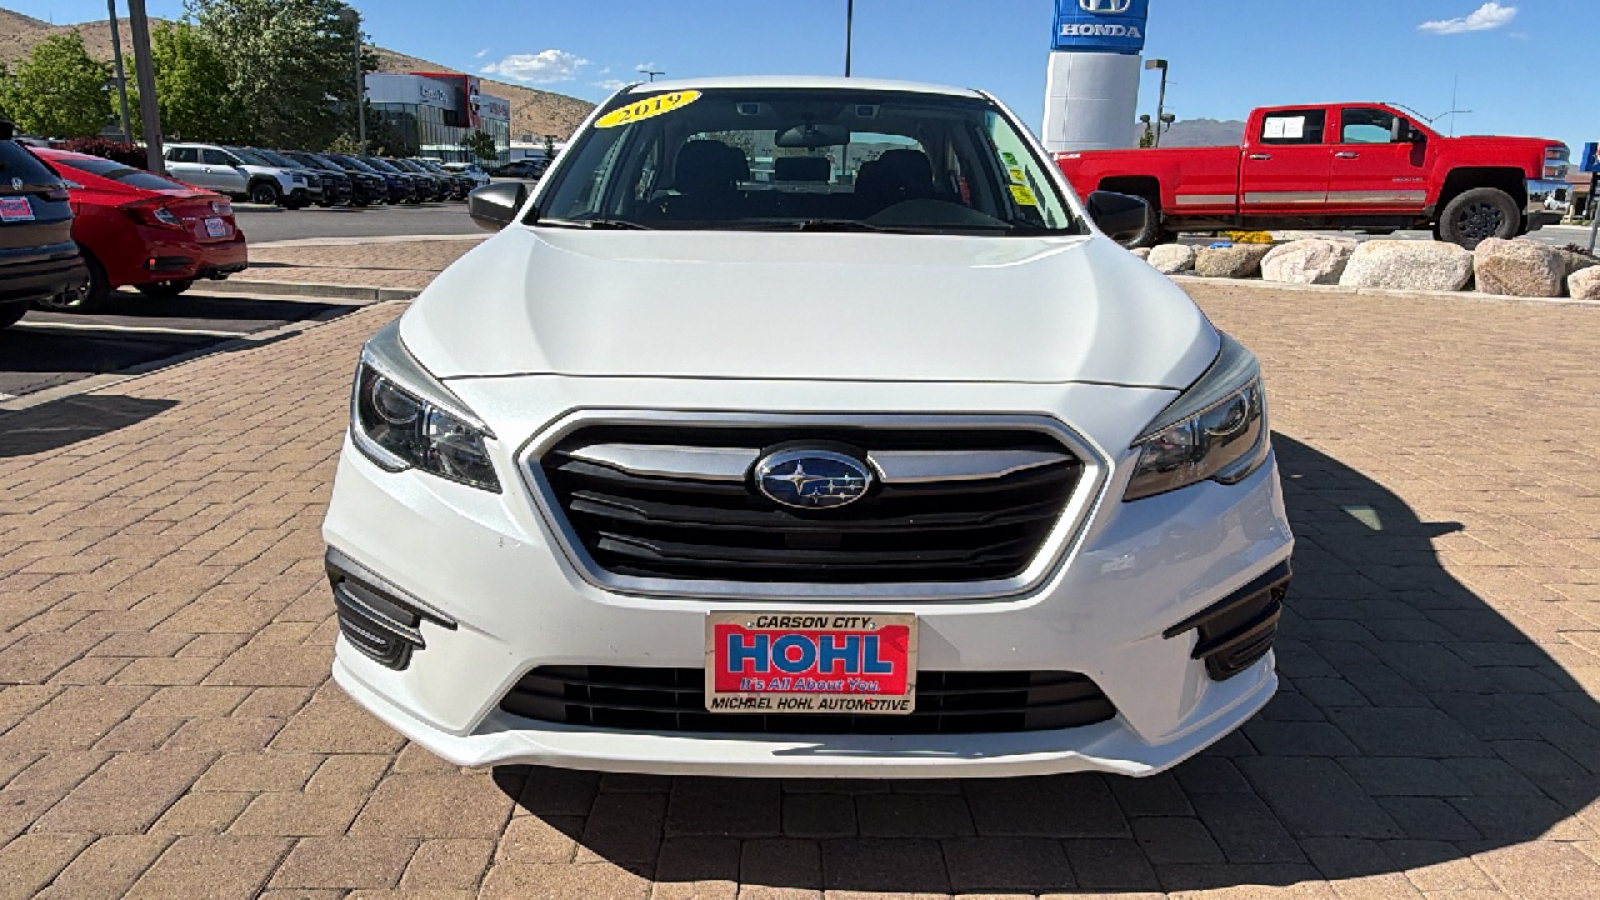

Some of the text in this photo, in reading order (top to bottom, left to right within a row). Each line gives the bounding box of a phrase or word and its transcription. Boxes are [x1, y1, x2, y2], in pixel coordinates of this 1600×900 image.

[1060, 23, 1141, 38] HONDA
[619, 94, 682, 121] 2019
[756, 616, 872, 628] CARSON CITY
[727, 633, 894, 675] HOHL
[739, 678, 764, 691] It's
[768, 678, 791, 691] All
[795, 678, 844, 691] About
[710, 697, 912, 711] MICHAEL HOHL AUTOMOTIVE
